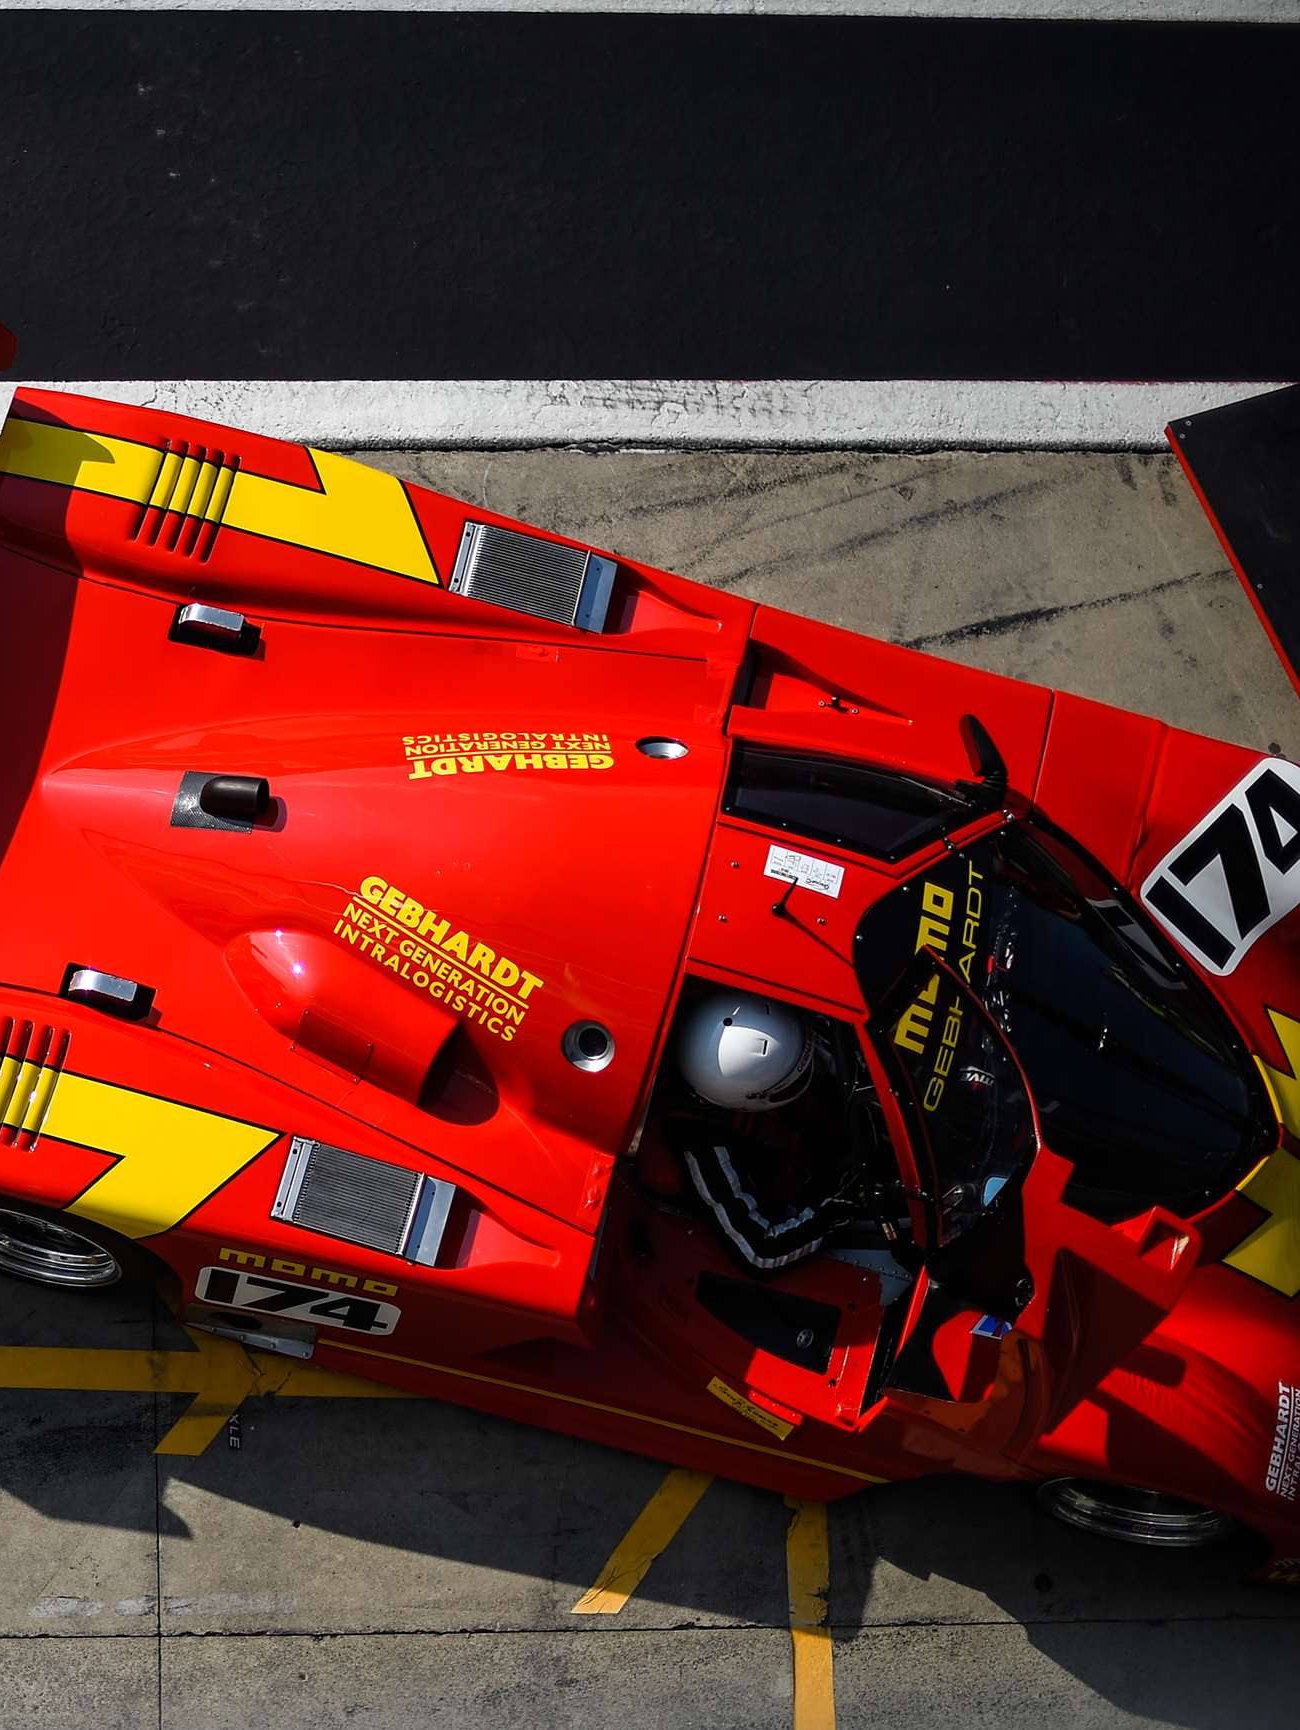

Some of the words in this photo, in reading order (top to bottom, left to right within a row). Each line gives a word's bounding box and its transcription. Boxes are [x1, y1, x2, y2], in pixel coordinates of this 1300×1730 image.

[402, 732, 609, 746] INTRALOGISTICS
[405, 740, 546, 756] GENERATION
[409, 754, 615, 780] GEBHARDT
[552, 741, 611, 751] NEXT
[1145, 768, 1300, 970] 174
[333, 919, 517, 1042] INTRALOGISTICS
[342, 902, 399, 945] NEXT
[398, 938, 526, 1026] GENERATION
[360, 875, 544, 1000] GEBHARDT
[203, 1268, 389, 1332] 174
[229, 1413, 240, 1449] XLE
[1265, 1378, 1291, 1491] GEBHARDT
[1280, 1463, 1293, 1497] NEXT
[1287, 1388, 1300, 1462] GENERATION
